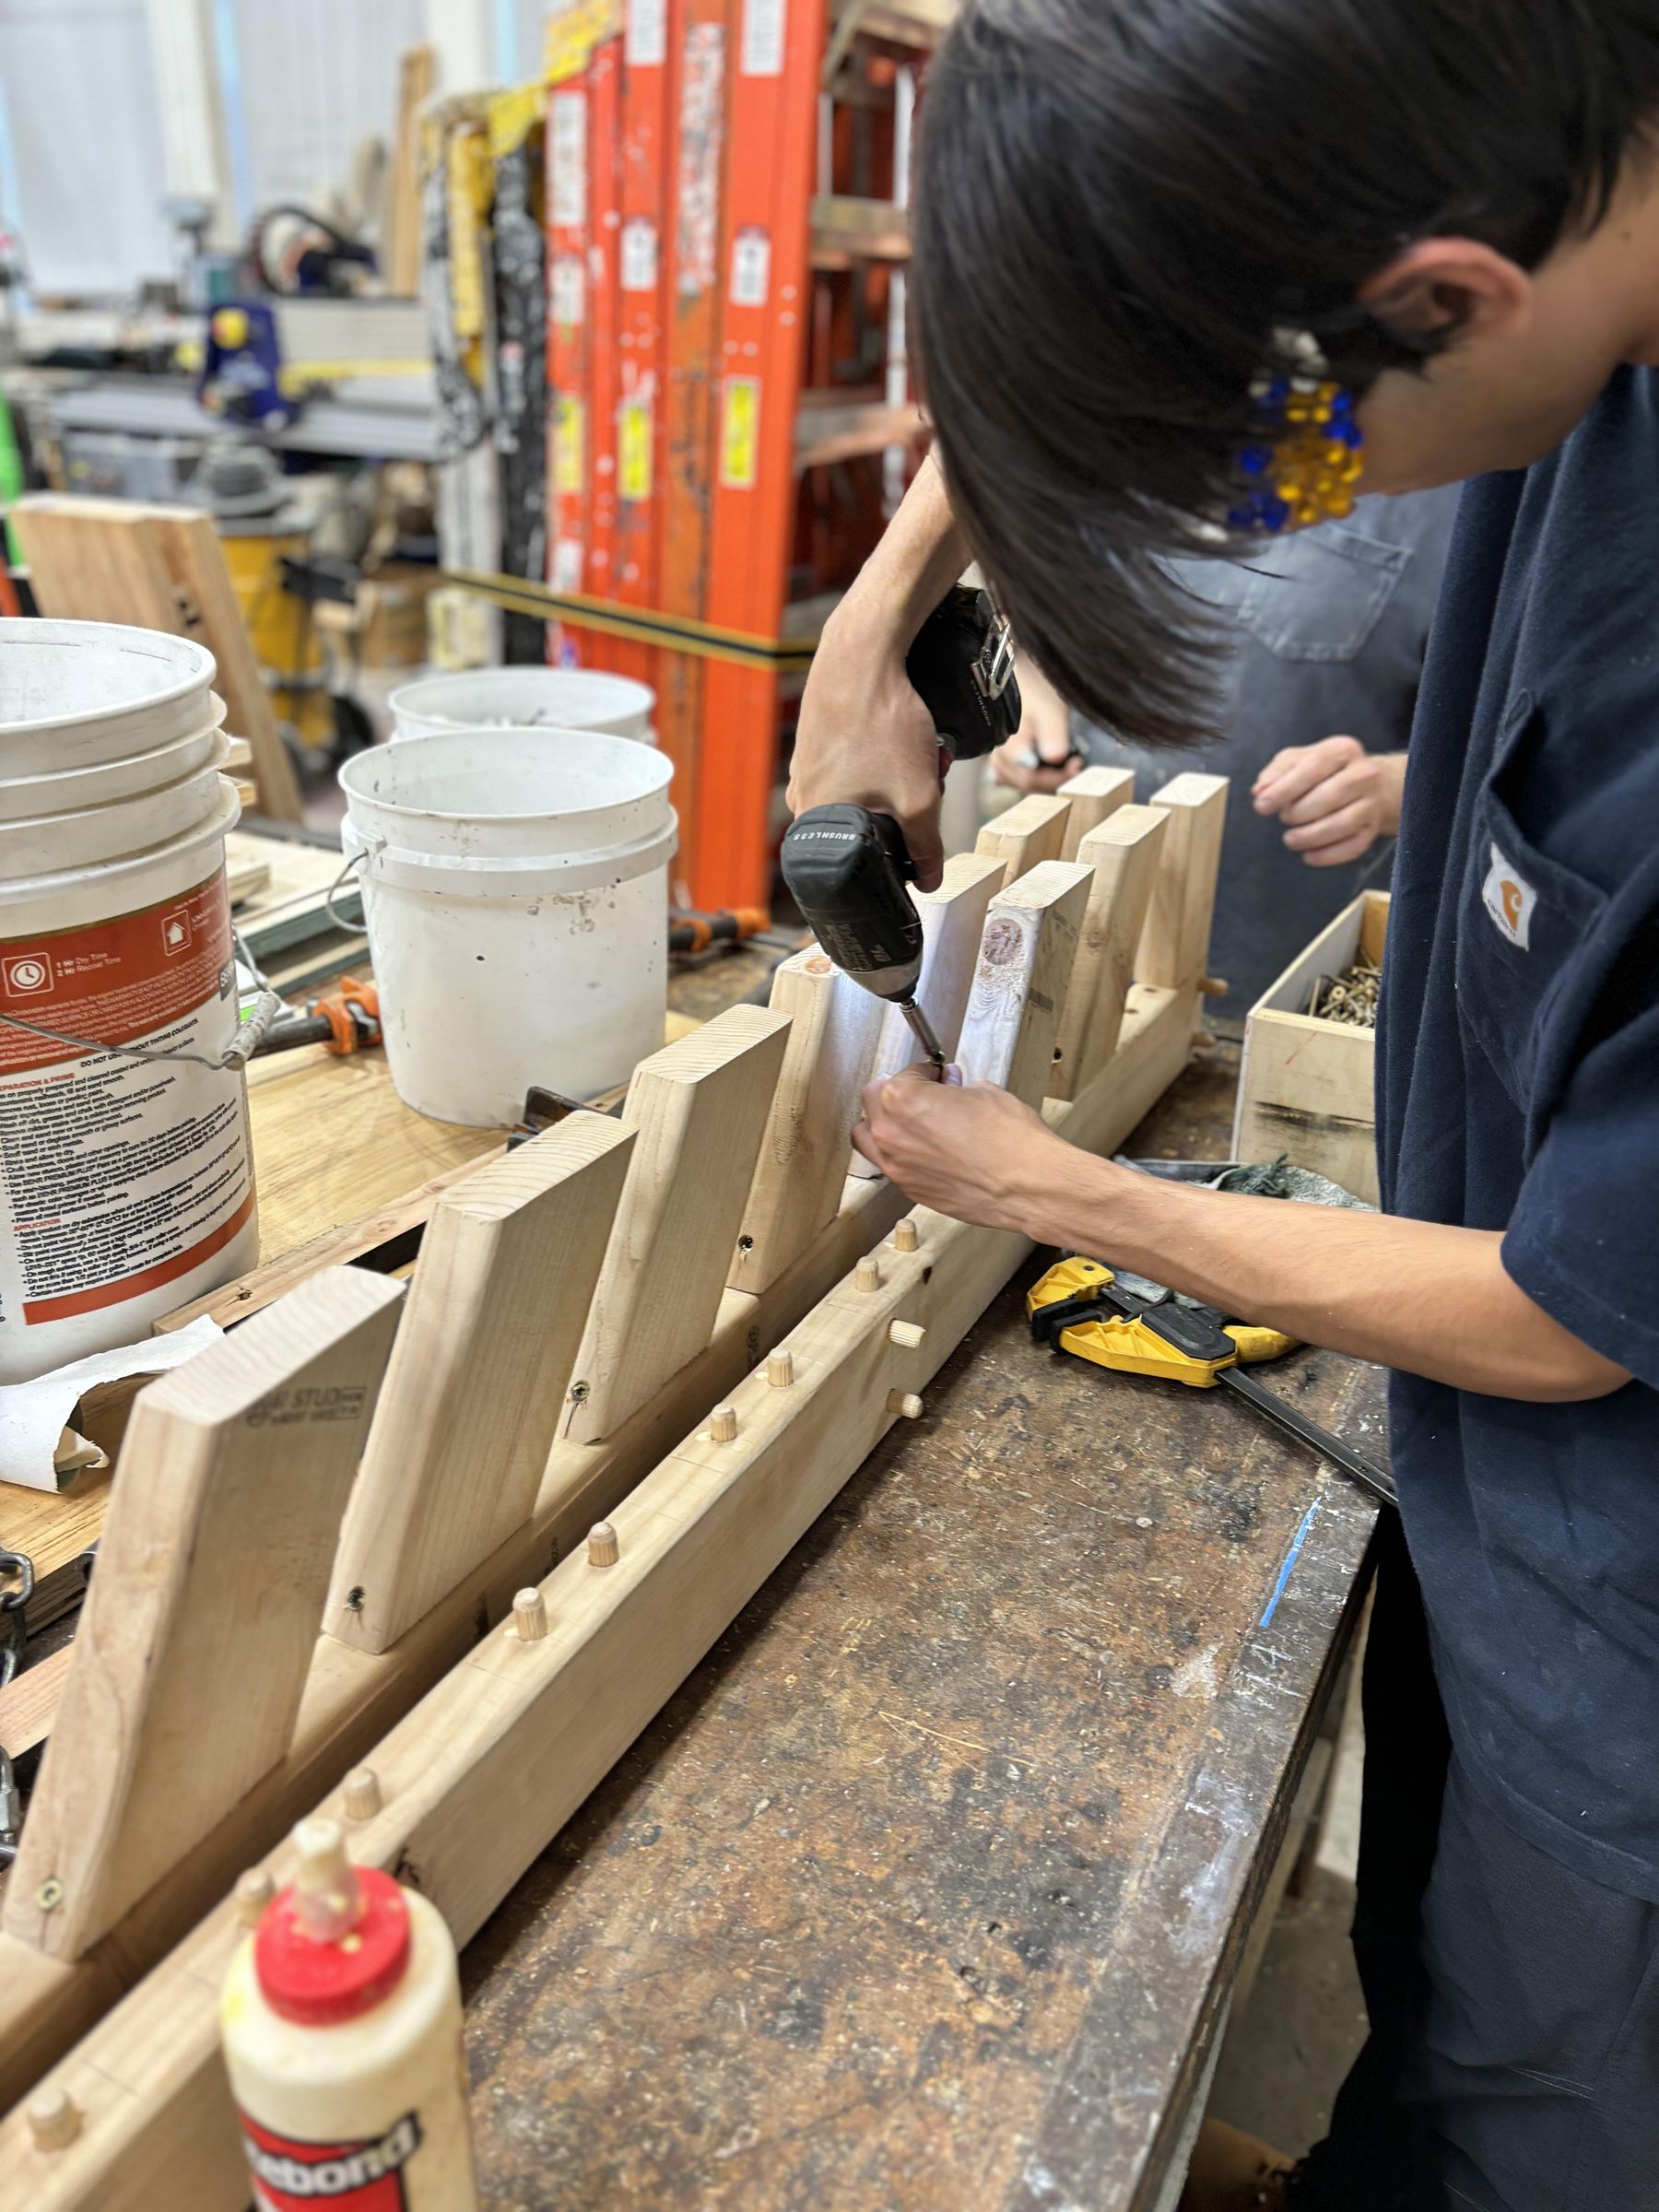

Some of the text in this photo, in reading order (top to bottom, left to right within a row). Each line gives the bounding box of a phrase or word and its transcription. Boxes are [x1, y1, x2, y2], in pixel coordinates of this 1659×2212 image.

[793, 831, 856, 841] BRUSHLESS
[89, 953, 108, 962] Time
[103, 957, 121, 967] Time
[92, 1057, 106, 1065] NOT
[108, 1053, 121, 1061] US
[14, 1218, 60, 1231] APPLICATION
